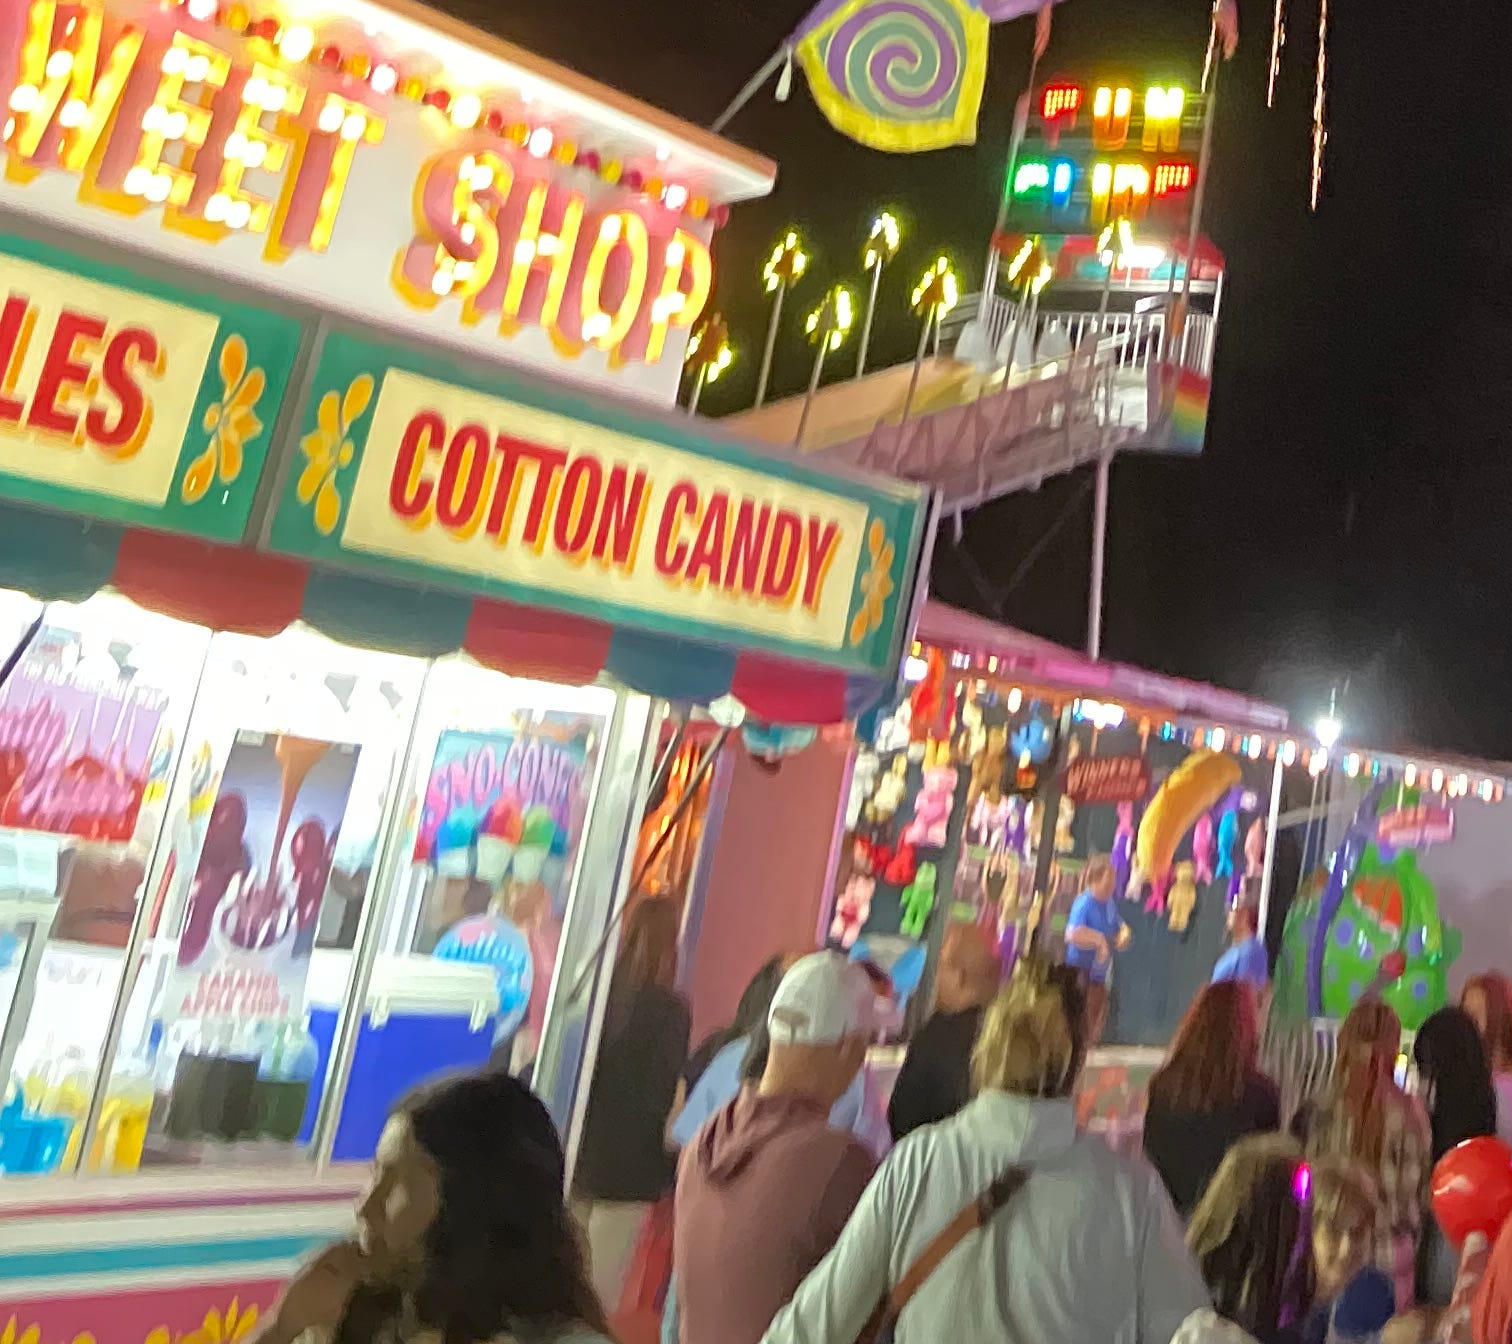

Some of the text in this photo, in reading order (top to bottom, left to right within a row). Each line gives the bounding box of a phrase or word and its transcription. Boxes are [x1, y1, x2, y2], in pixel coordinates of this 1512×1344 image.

[392, 150, 713, 368] SHOP
[388, 410, 842, 614] COTTON CANDY
